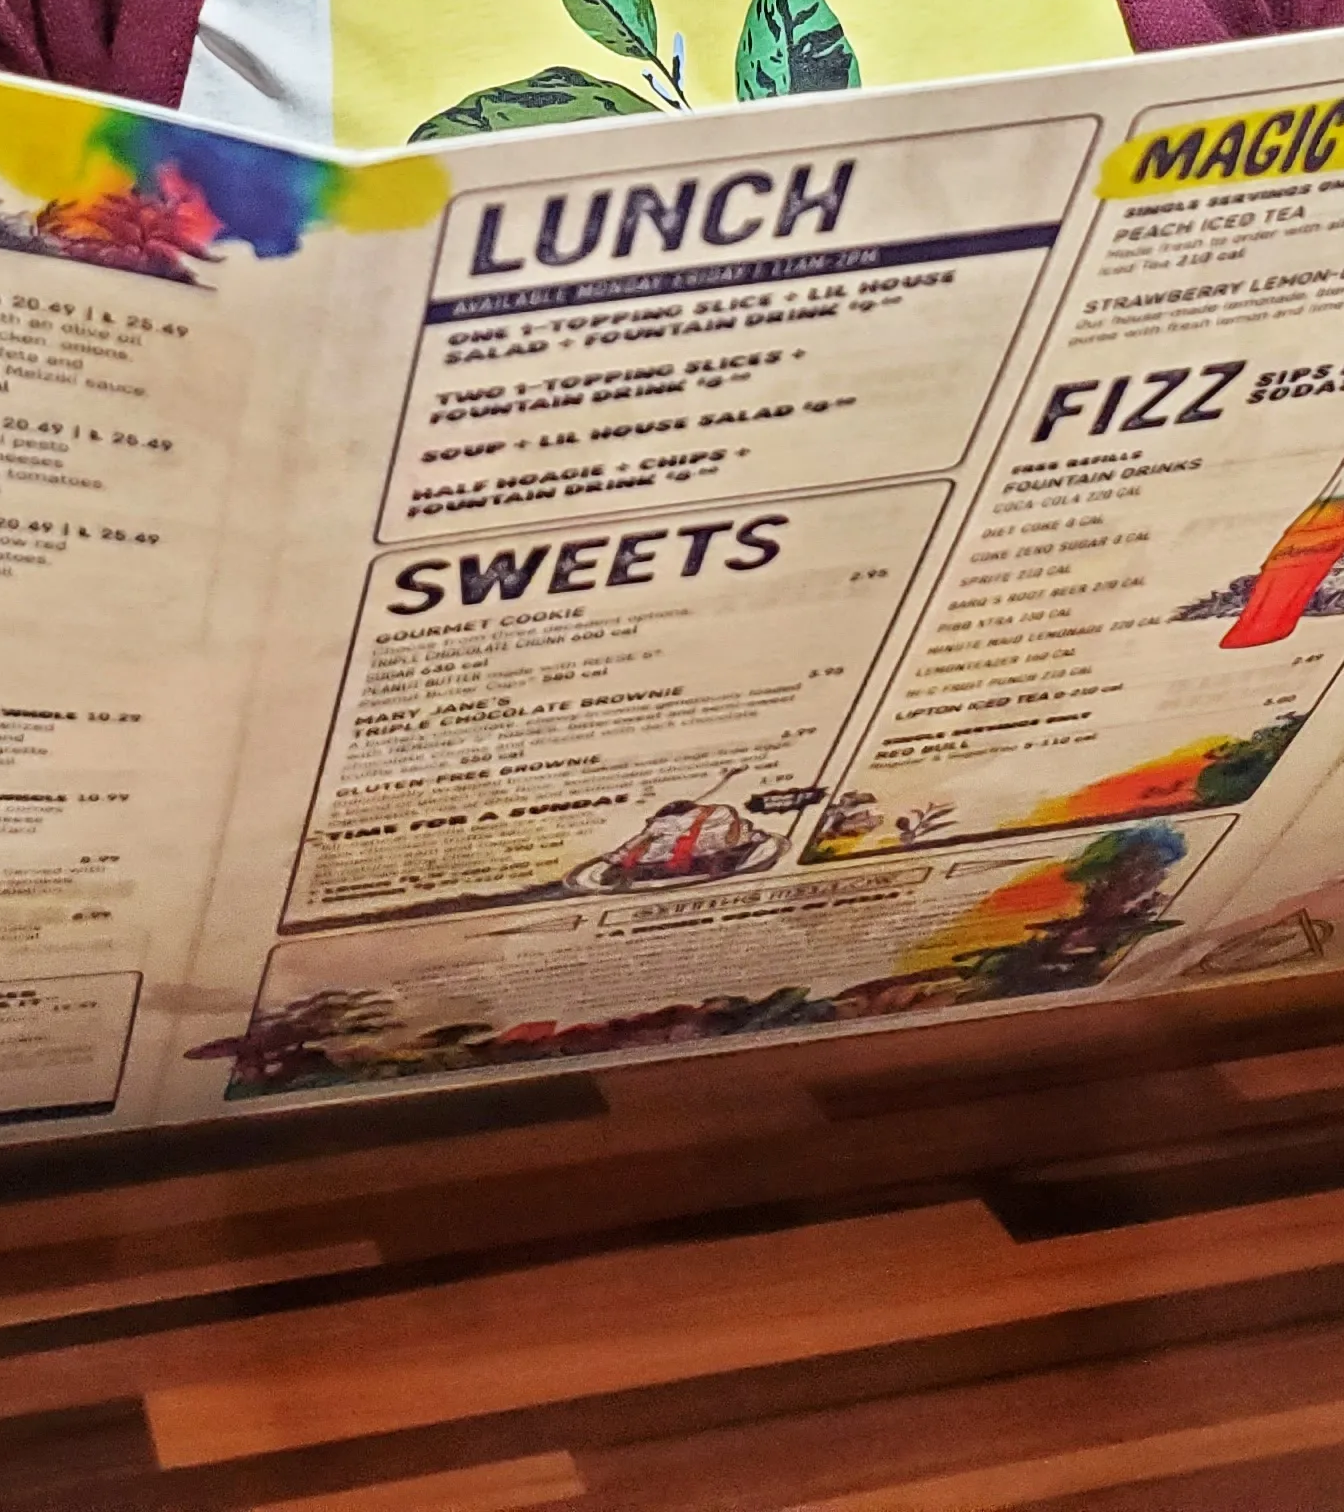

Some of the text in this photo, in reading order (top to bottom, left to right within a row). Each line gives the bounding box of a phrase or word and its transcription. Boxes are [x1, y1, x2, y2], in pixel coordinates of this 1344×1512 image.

[467, 158, 857, 277] LUNCH
[1123, 198, 1199, 219] SINGLE
[1206, 183, 1312, 208] SERVINGS
[1112, 220, 1195, 243] PEACH
[1201, 213, 1256, 231] ICED
[1263, 205, 1306, 223] TEA
[1216, 247, 1247, 261] cal
[448, 269, 956, 346] ONE 1-TOPPING SLICE LIL HOUSE
[1083, 280, 1245, 314] STRAWBERRY
[444, 340, 550, 365] SALAD
[584, 319, 737, 347] FOUNTAIN
[744, 303, 839, 327] DRINK
[435, 386, 506, 406] TWO
[516, 363, 675, 395] 1-TOPPING
[684, 349, 783, 374] SLICES
[1254, 366, 1342, 387] SIPS
[428, 392, 585, 425] FOUNTAIN
[591, 379, 687, 403] DRINK
[1029, 359, 1248, 443] FIZZ
[421, 441, 506, 463] SOUP
[539, 432, 579, 447] LIL
[590, 416, 689, 440] HOUSE
[697, 404, 794, 427] SALAD
[407, 474, 655, 518] FOUNTAIN DRINK
[411, 448, 728, 501] HALF HOAGIE CHIPS
[1002, 469, 1114, 495] FOUNTAIN
[1120, 457, 1204, 480] DRINKS
[385, 513, 790, 616] SWEETS
[375, 606, 586, 644] GOURMET COOKIE
[354, 695, 511, 726] MARY JANE'S
[354, 686, 684, 739] TRIPLE CHOCOLATE BROWNIE
[894, 691, 1049, 721] LIPTON ICED TEA
[336, 753, 602, 798] GLUTEN FREE BROWNIE
[326, 824, 398, 842] TIME
